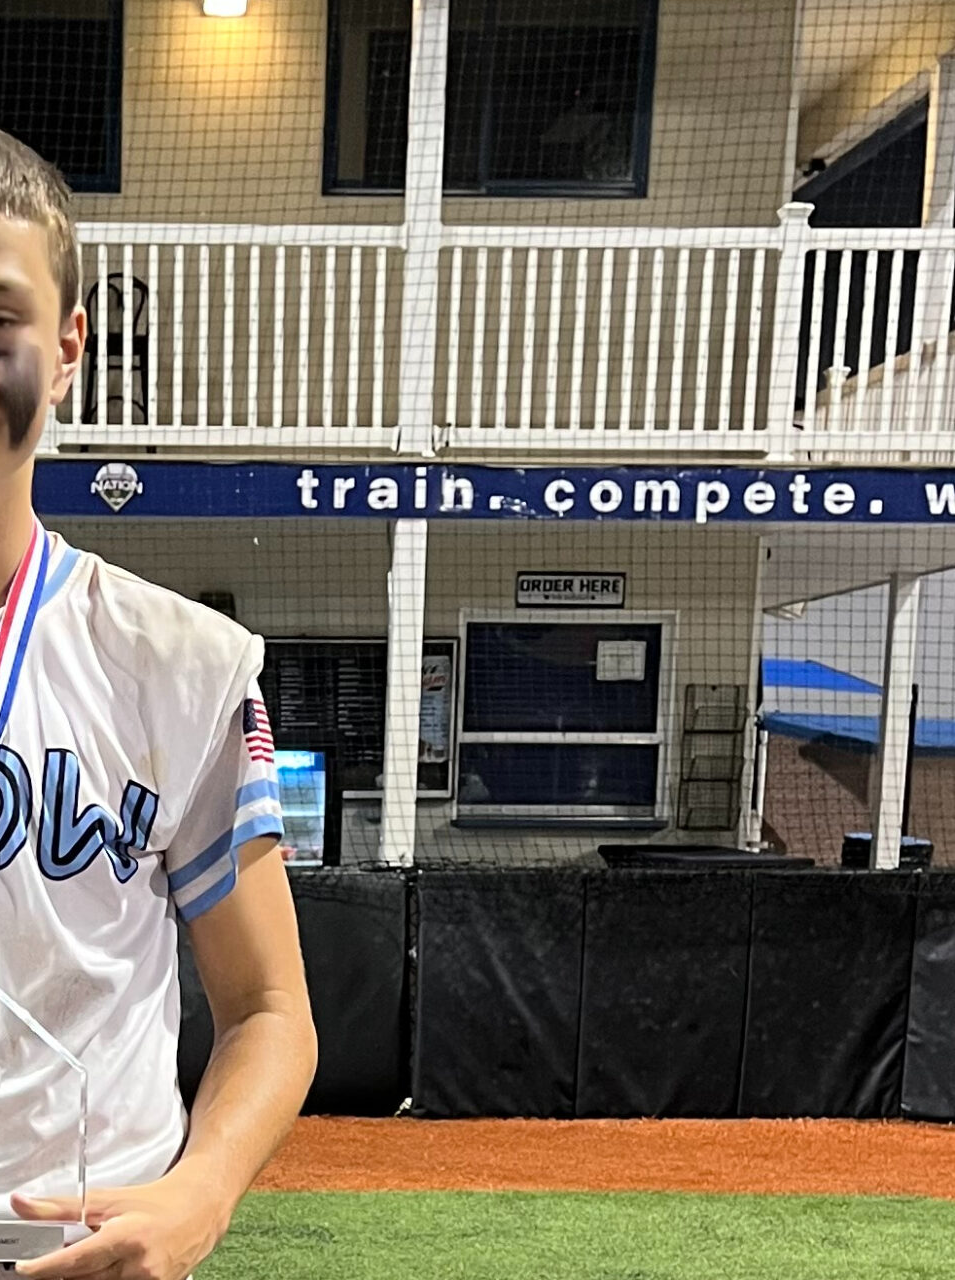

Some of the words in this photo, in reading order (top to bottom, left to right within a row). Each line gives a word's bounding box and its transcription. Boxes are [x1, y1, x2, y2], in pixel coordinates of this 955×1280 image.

[90, 481, 143, 494] NATION
[297, 469, 503, 512] train.
[545, 474, 883, 524] compete.
[519, 578, 574, 592] ORDER
[579, 579, 621, 594] HERE
